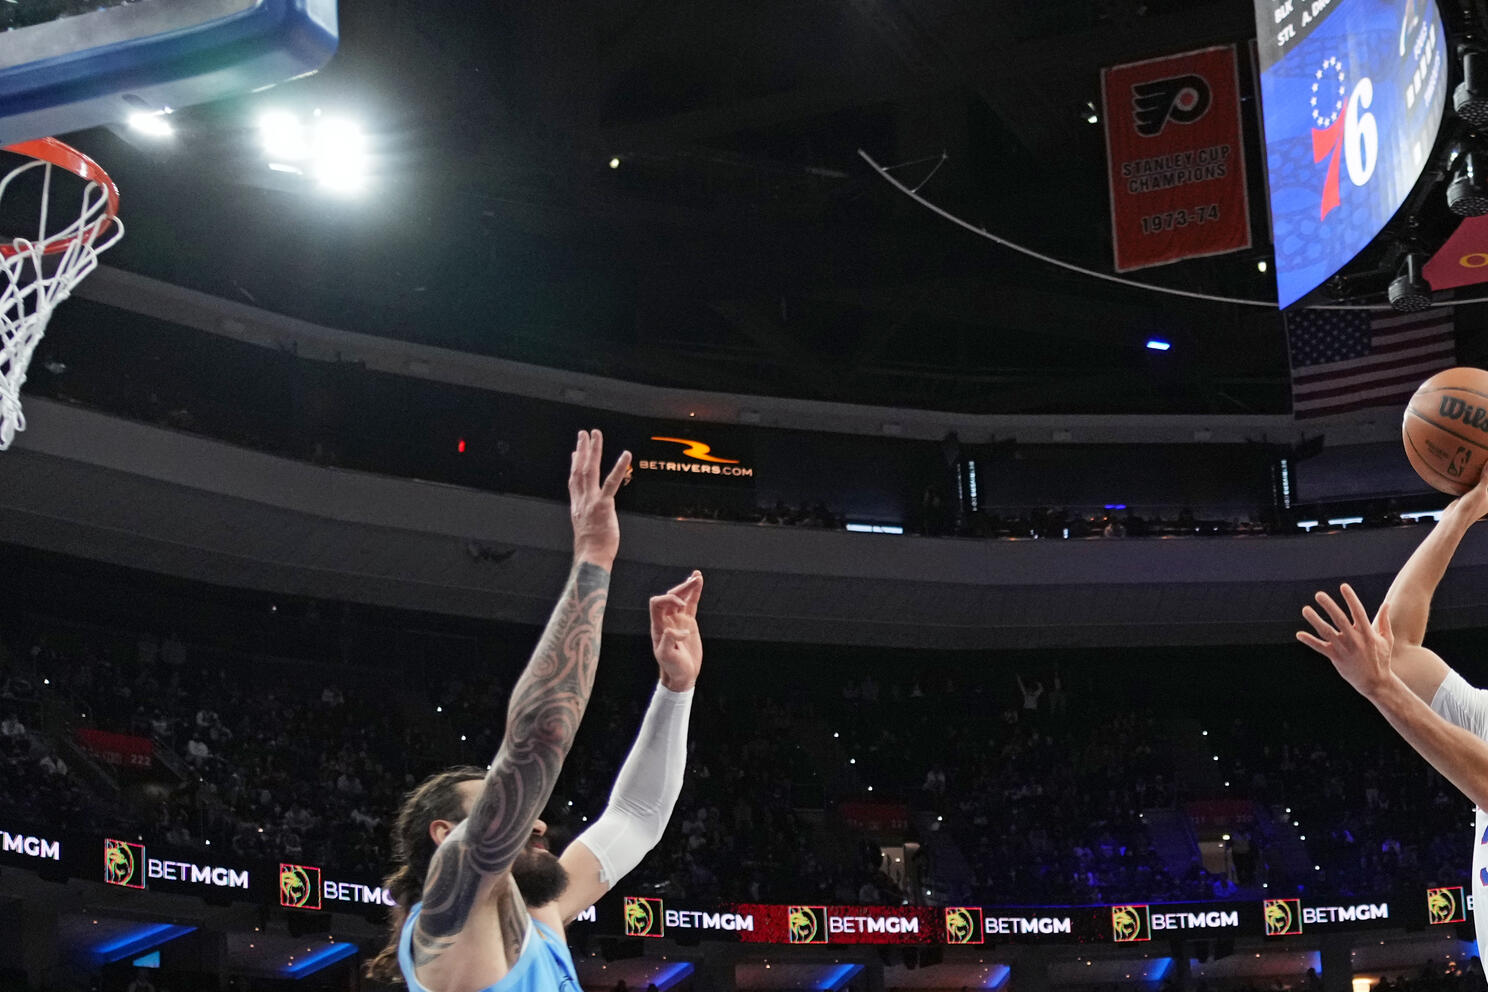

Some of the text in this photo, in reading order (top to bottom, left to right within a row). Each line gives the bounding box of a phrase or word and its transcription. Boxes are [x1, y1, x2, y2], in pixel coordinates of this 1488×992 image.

[1122, 144, 1231, 177] STANLEY CUP
[1128, 163, 1228, 195] CHAMPIONS
[1141, 204, 1220, 234] 1973-74
[639, 460, 753, 477] BETRIVERS.COM
[0, 831, 60, 861] MGM
[148, 858, 249, 889] BETMGM
[665, 908, 755, 933] BETMGM
[829, 916, 919, 934] BETMGM
[985, 916, 1071, 934] BETMGM
[1151, 911, 1239, 930] BETMGM
[1303, 903, 1389, 924] BETMGM
